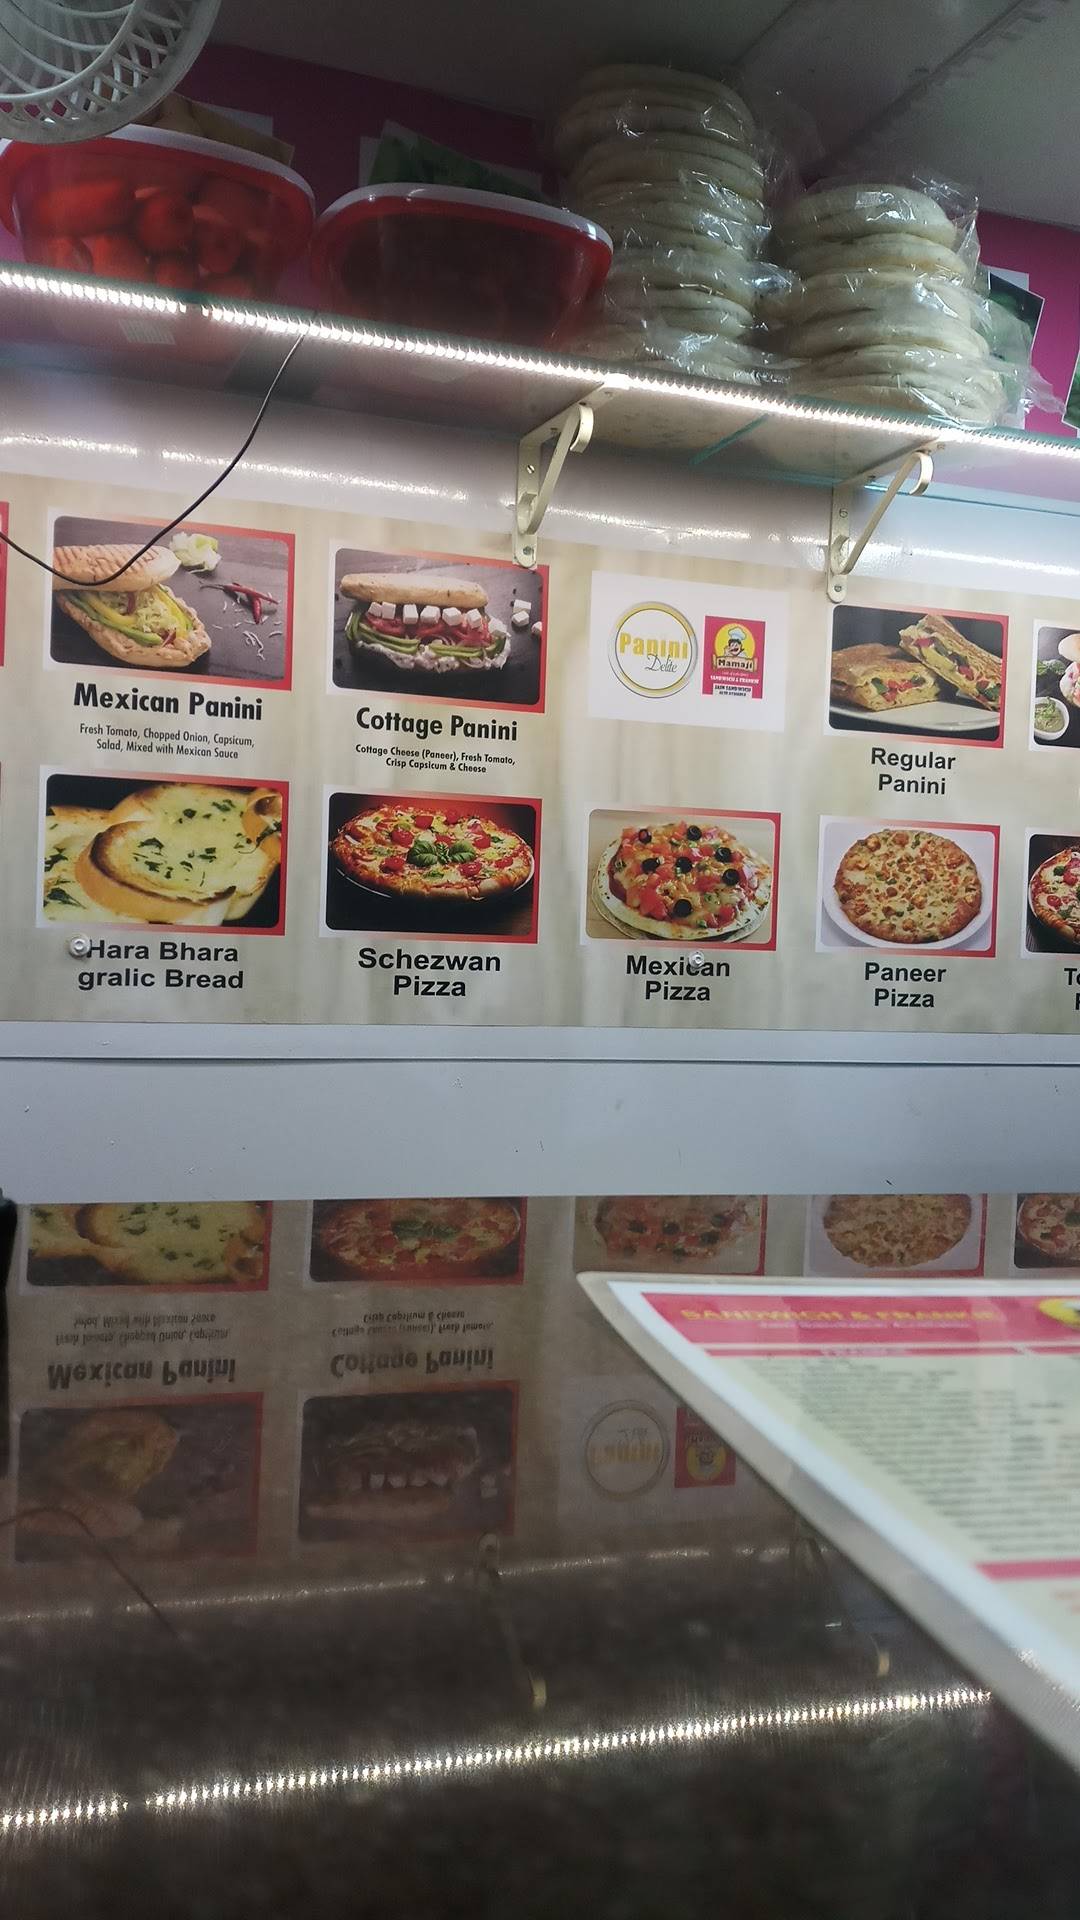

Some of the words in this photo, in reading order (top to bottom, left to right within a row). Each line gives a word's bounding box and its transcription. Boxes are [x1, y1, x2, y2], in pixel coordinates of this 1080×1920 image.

[620, 632, 689, 660] Panini
[73, 682, 179, 714] Mexican
[189, 691, 262, 720] Panini
[356, 707, 443, 740] Cottage
[451, 715, 517, 741] Panini
[80, 723, 103, 735] Fresh
[106, 725, 140, 739] Tomato,
[143, 728, 180, 741] Chopped
[183, 731, 210, 745] Onion,
[213, 733, 255, 748] Capsicum,
[97, 739, 123, 752] Salad,
[126, 741, 153, 753] Mixed
[155, 743, 174, 755] with
[176, 745, 211, 758] Mexican
[214, 747, 238, 759] Sauce
[355, 744, 388, 756] Cottage
[390, 747, 420, 757] Cheese
[422, 749, 459, 762] (Paneer),
[461, 752, 482, 762] Fresh
[484, 754, 516, 766] Tomato,
[871, 747, 956, 771] Regular
[386, 758, 406, 768] Crisp
[409, 759, 447, 771] Capsicum
[449, 763, 456, 771] &
[458, 763, 486, 773] Cheese
[878, 774, 946, 795] Panini
[87, 939, 149, 960] Hara
[160, 941, 238, 962] Bhara
[358, 947, 501, 971] Schezwan
[78, 968, 155, 991] gralic
[166, 969, 243, 989] Bread
[864, 962, 947, 983] Paneer
[394, 975, 466, 996] Pizza
[645, 981, 710, 1001] Pizza
[874, 988, 935, 1008] Pizza
